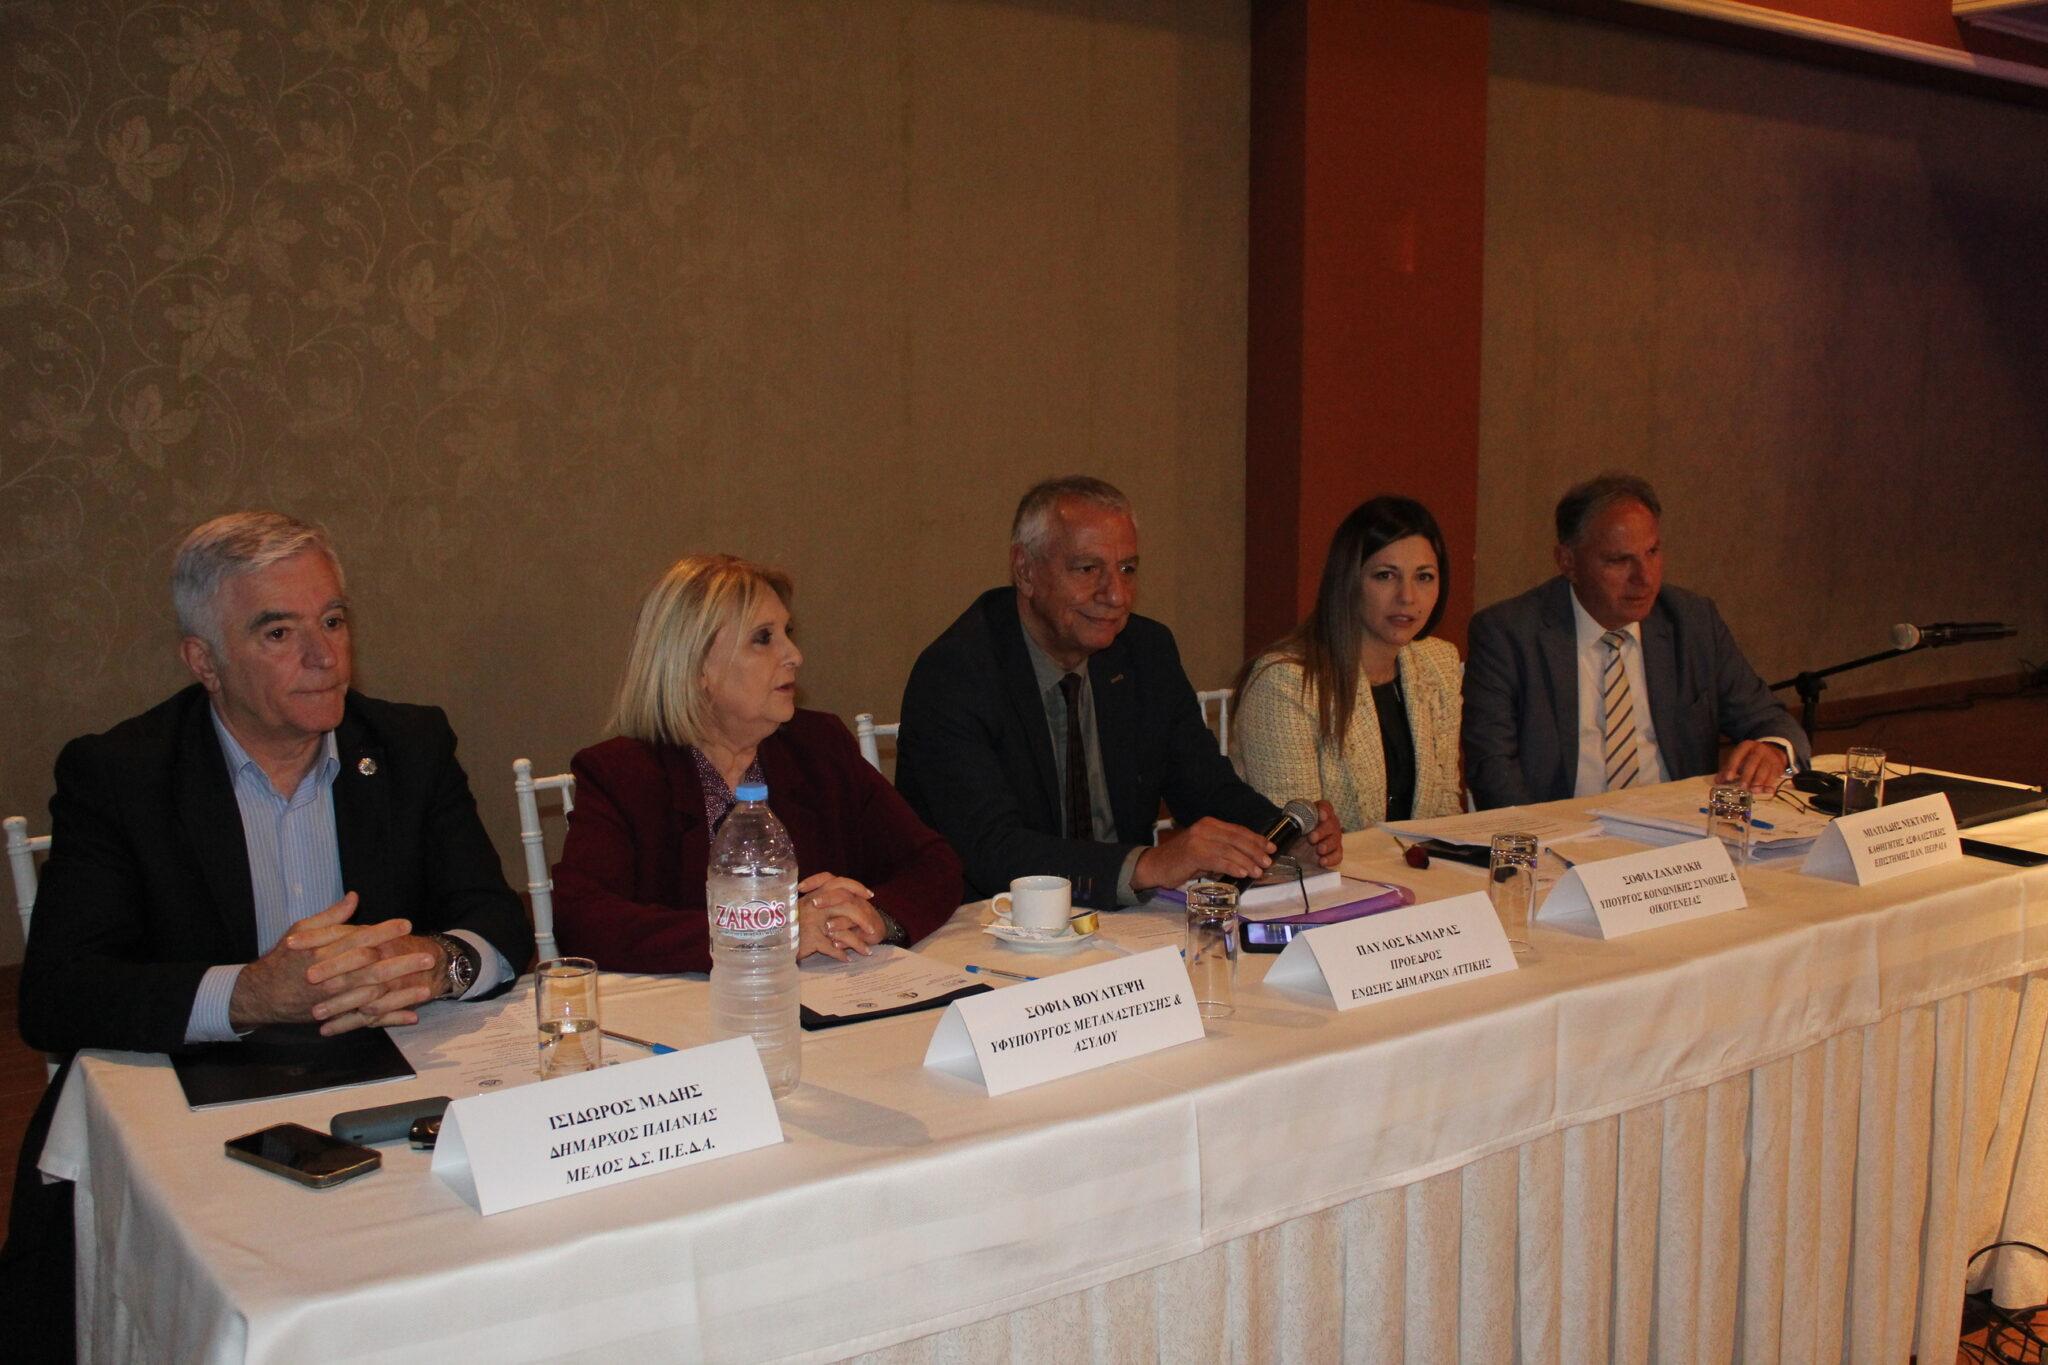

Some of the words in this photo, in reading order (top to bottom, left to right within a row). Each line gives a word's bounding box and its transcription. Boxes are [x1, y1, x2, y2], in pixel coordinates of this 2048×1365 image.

[1622, 871, 1654, 885] ΣΟΦΙΑ
[1655, 860, 1703, 879] ΖΑΧΑΡΑΚΗ
[1600, 894, 1642, 909] ΥΠΟΥΡΓΟΣ
[1644, 882, 1693, 900] ΚΟΙΝΩΝΙΚΗΣ
[1694, 874, 1729, 889] ΣΥΝΟΧΗΣ
[1649, 895, 1702, 915] ΟΙΚΟΓΕΝΕΙΑΣ
[1356, 937, 1405, 956] ΠΑΥΛΟΣ
[1405, 924, 1461, 945] ΚΑΜΑΡΑΣ
[1390, 949, 1442, 970] ΠΡΟΕΔΡΟΣ
[1351, 981, 1393, 1000] ΕΝΩΣΗΣ
[1396, 968, 1449, 989] ΔΗΜΑΡΧΩΝ
[1451, 958, 1492, 976] ΑΤΤΙΚΗΣ
[1024, 998, 1071, 1019] ΣΟΦΙΑ
[1072, 978, 1145, 1007] ΒΟΥΛΤΕΨΗ
[990, 1022, 1071, 1053] ΥΦΥΠΟΥΡΓΟΣ
[1074, 997, 1172, 1032] ΜΕΤΑΝΑΣΤΕΥΣΗΣ
[1174, 994, 1182, 1006] &
[1074, 1031, 1118, 1053] ΑΣΥΛΟΥ
[549, 1098, 636, 1130] ΙΣΙΔΩΡΟΣ
[639, 1084, 703, 1110] ΜΑΔΗΣ
[550, 1126, 639, 1159] ΔΗΜΑΡΧΟΣ
[643, 1107, 718, 1137] ΠΑΙΑΝΙΑΣ
[566, 1158, 623, 1184] ΜΕΛΟΣ
